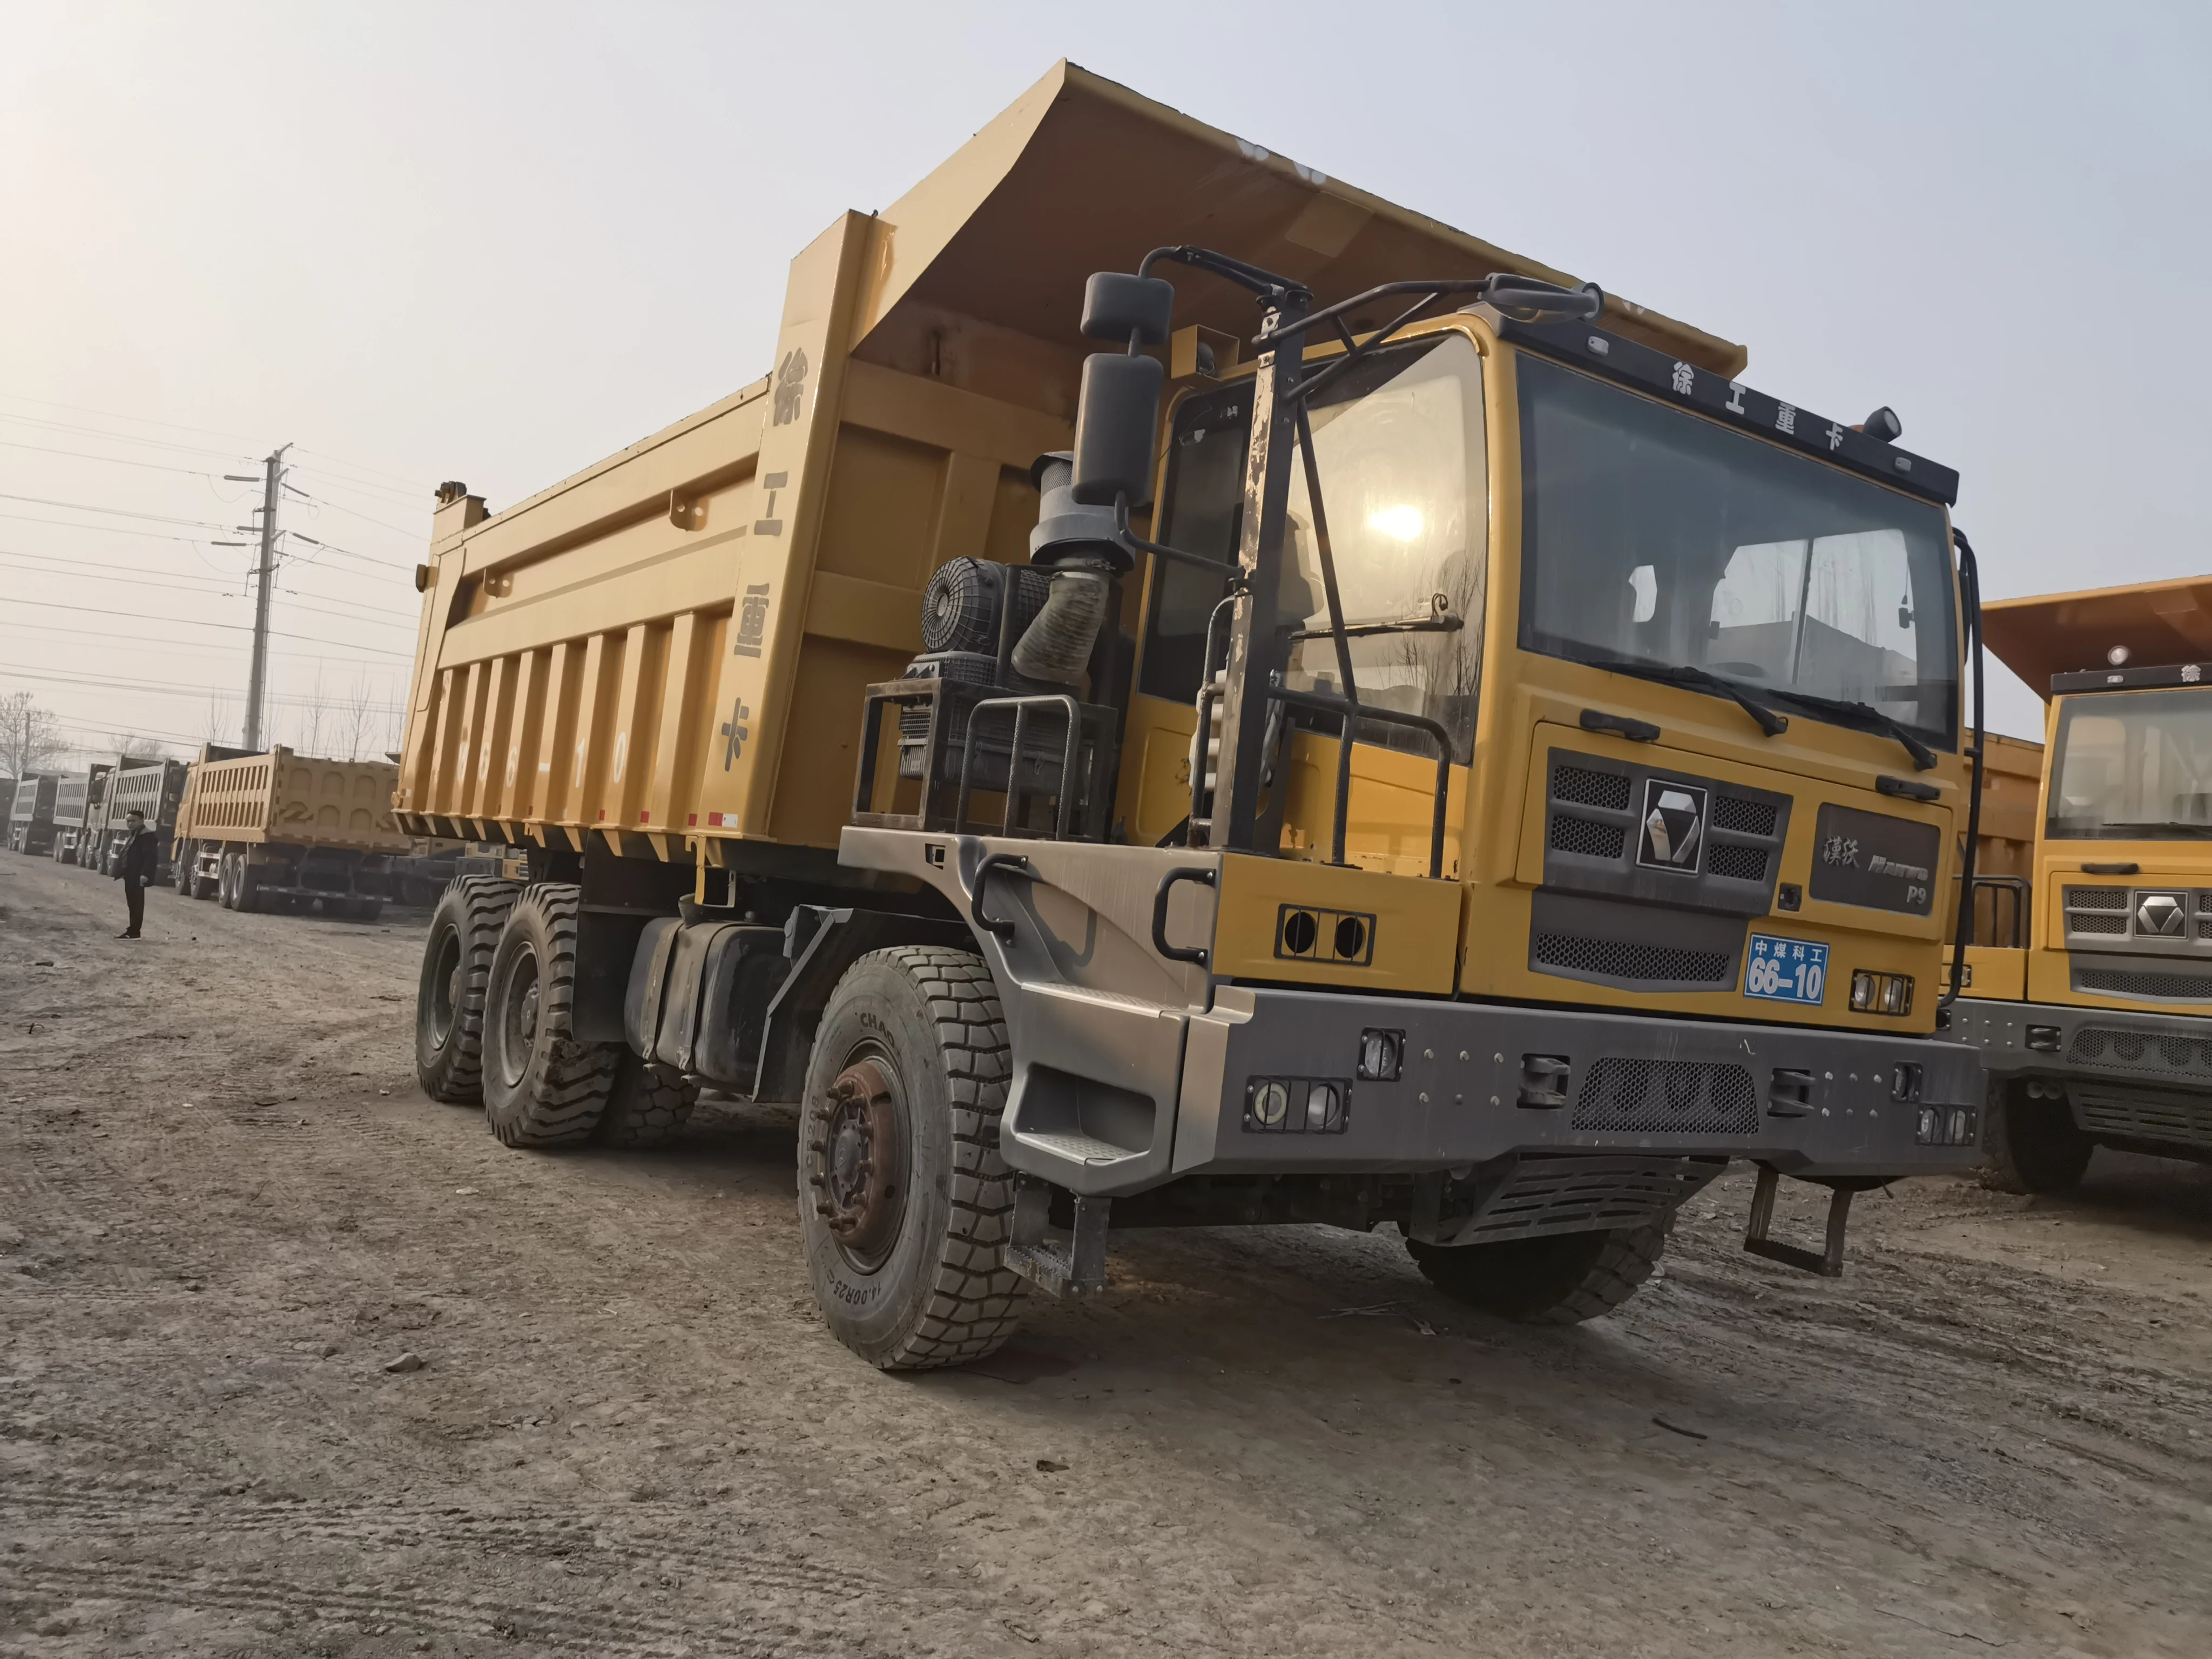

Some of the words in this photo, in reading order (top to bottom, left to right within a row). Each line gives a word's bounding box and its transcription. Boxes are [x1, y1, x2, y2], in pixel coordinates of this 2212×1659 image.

[1672, 361, 1844, 450] 徐工重卡
[2181, 665, 2201, 682] 徐
[1906, 885, 1926, 905] P9
[1755, 939, 1823, 962] 中煤科工
[1749, 957, 1822, 999] 66-10
